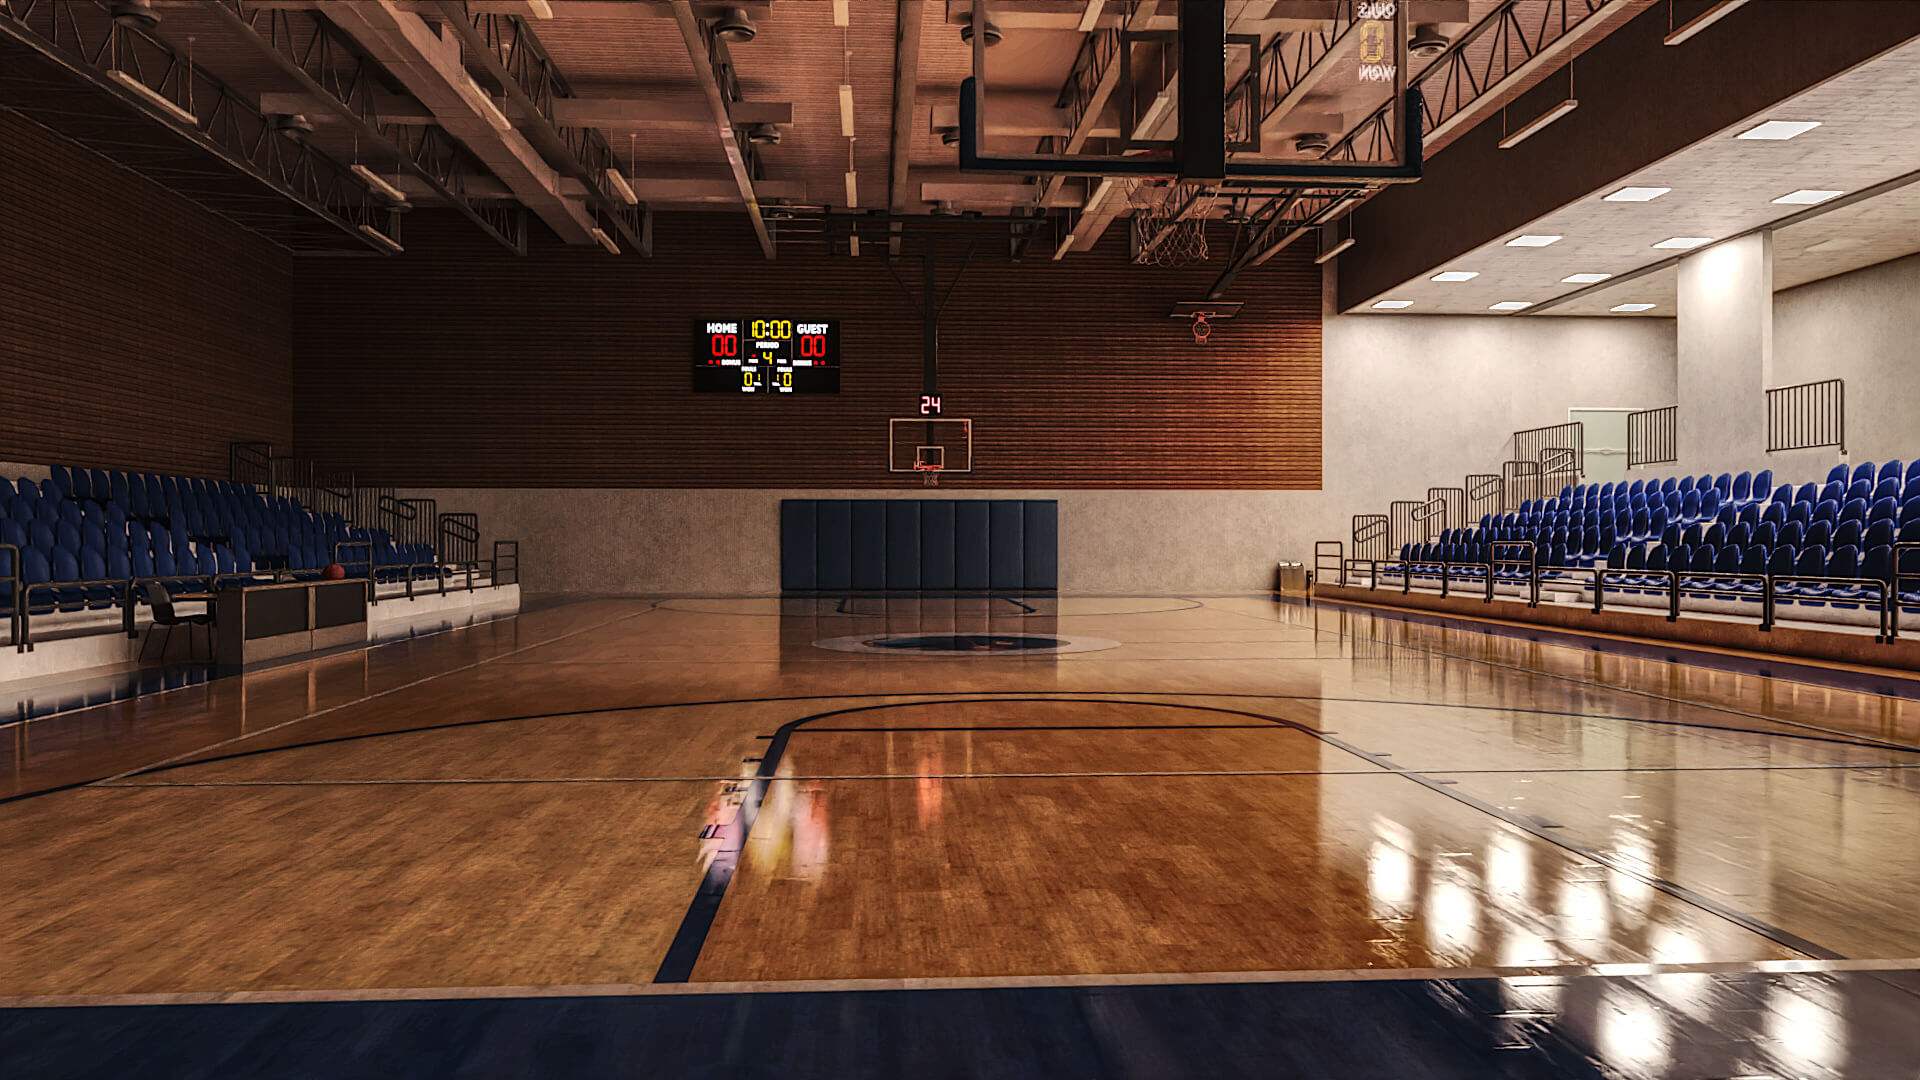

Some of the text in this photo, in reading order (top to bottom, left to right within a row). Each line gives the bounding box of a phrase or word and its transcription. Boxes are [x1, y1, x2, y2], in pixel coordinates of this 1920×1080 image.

[706, 322, 737, 334] HOME
[751, 319, 791, 339] 10:00
[796, 323, 828, 334] GUEST
[711, 334, 737, 357] 00
[755, 341, 779, 349] PERIOD
[800, 335, 826, 357] 00
[762, 351, 773, 365] 4
[744, 372, 753, 386] 0
[783, 372, 792, 387] 0
[920, 395, 941, 414] 24
